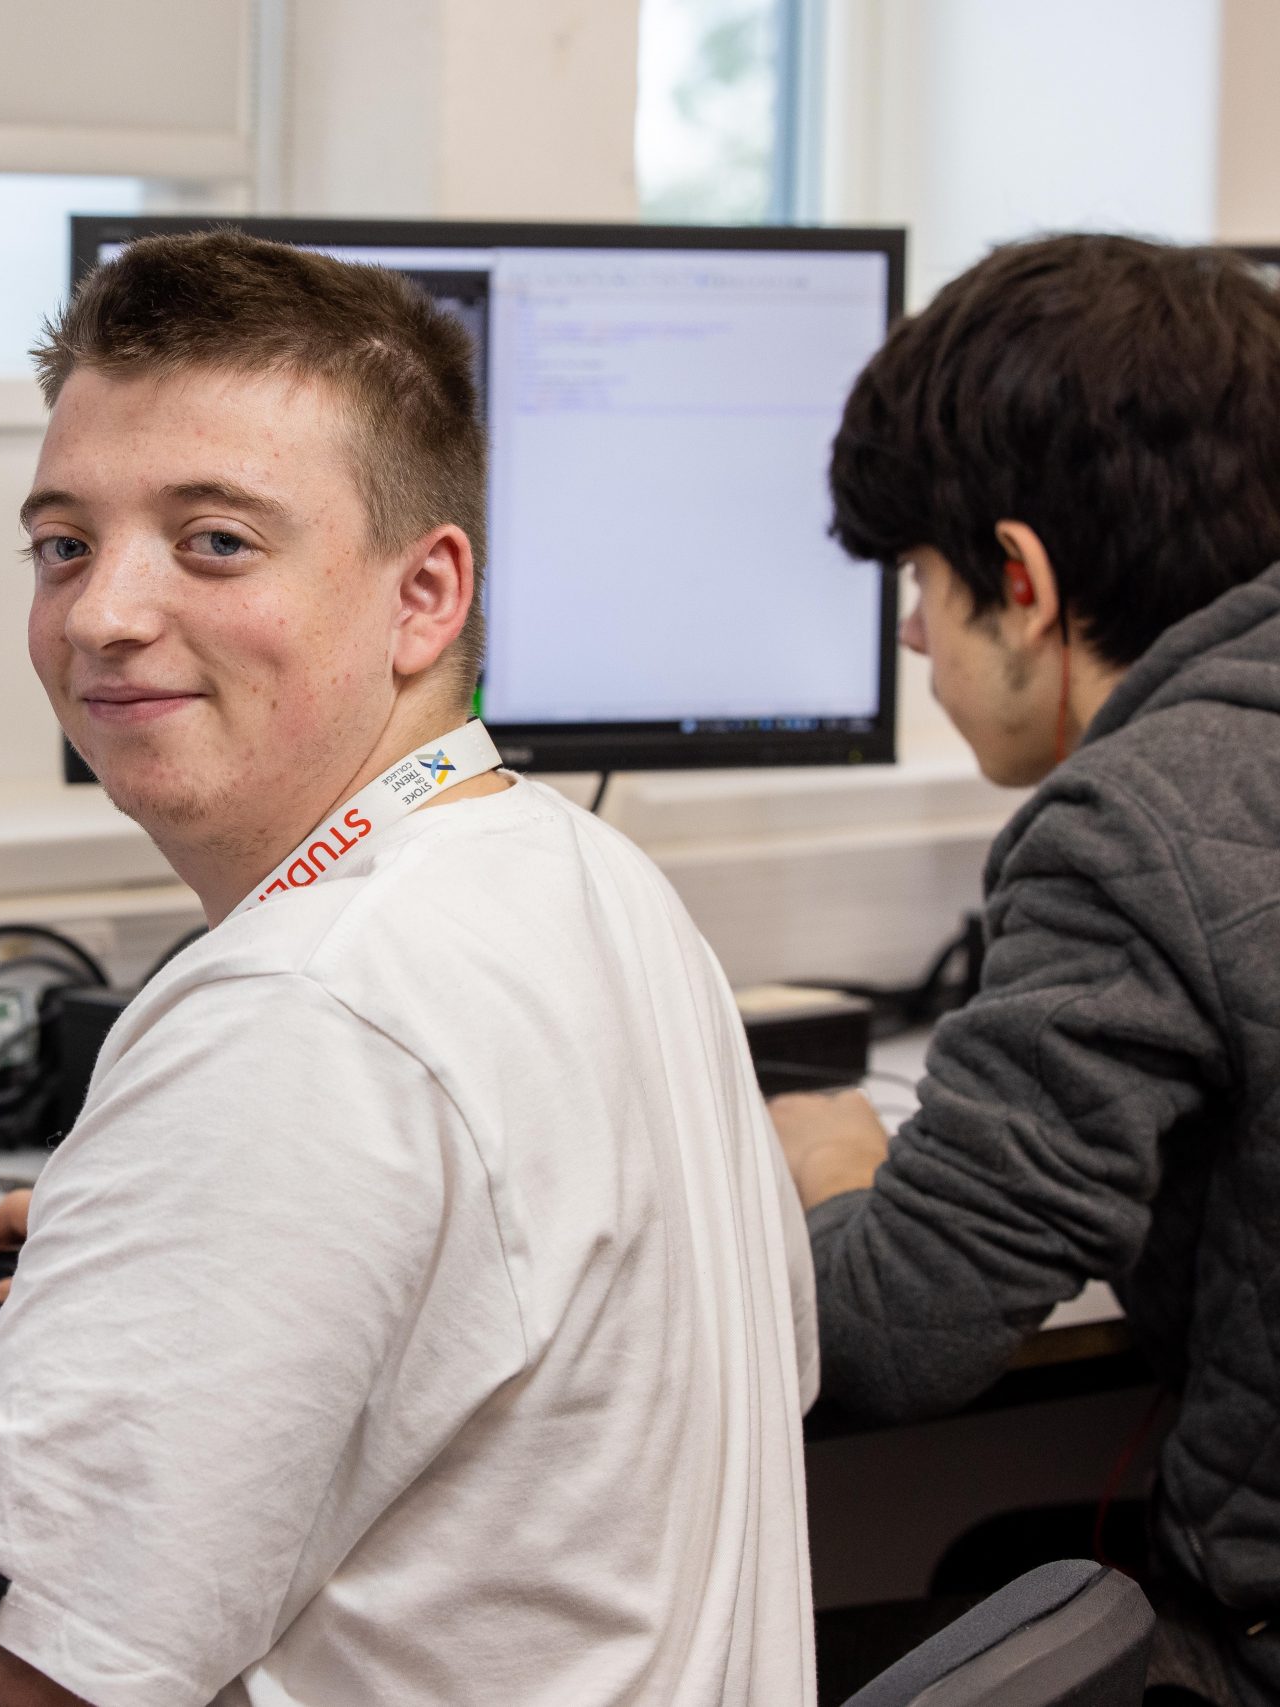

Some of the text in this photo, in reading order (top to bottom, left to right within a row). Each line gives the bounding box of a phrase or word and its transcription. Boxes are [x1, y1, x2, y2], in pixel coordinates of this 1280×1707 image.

[381, 761, 413, 786] COLLEGE
[391, 769, 421, 793] TRENT
[414, 776, 425, 786] ON
[402, 782, 433, 806] STOKE
[258, 808, 372, 902] STUD
